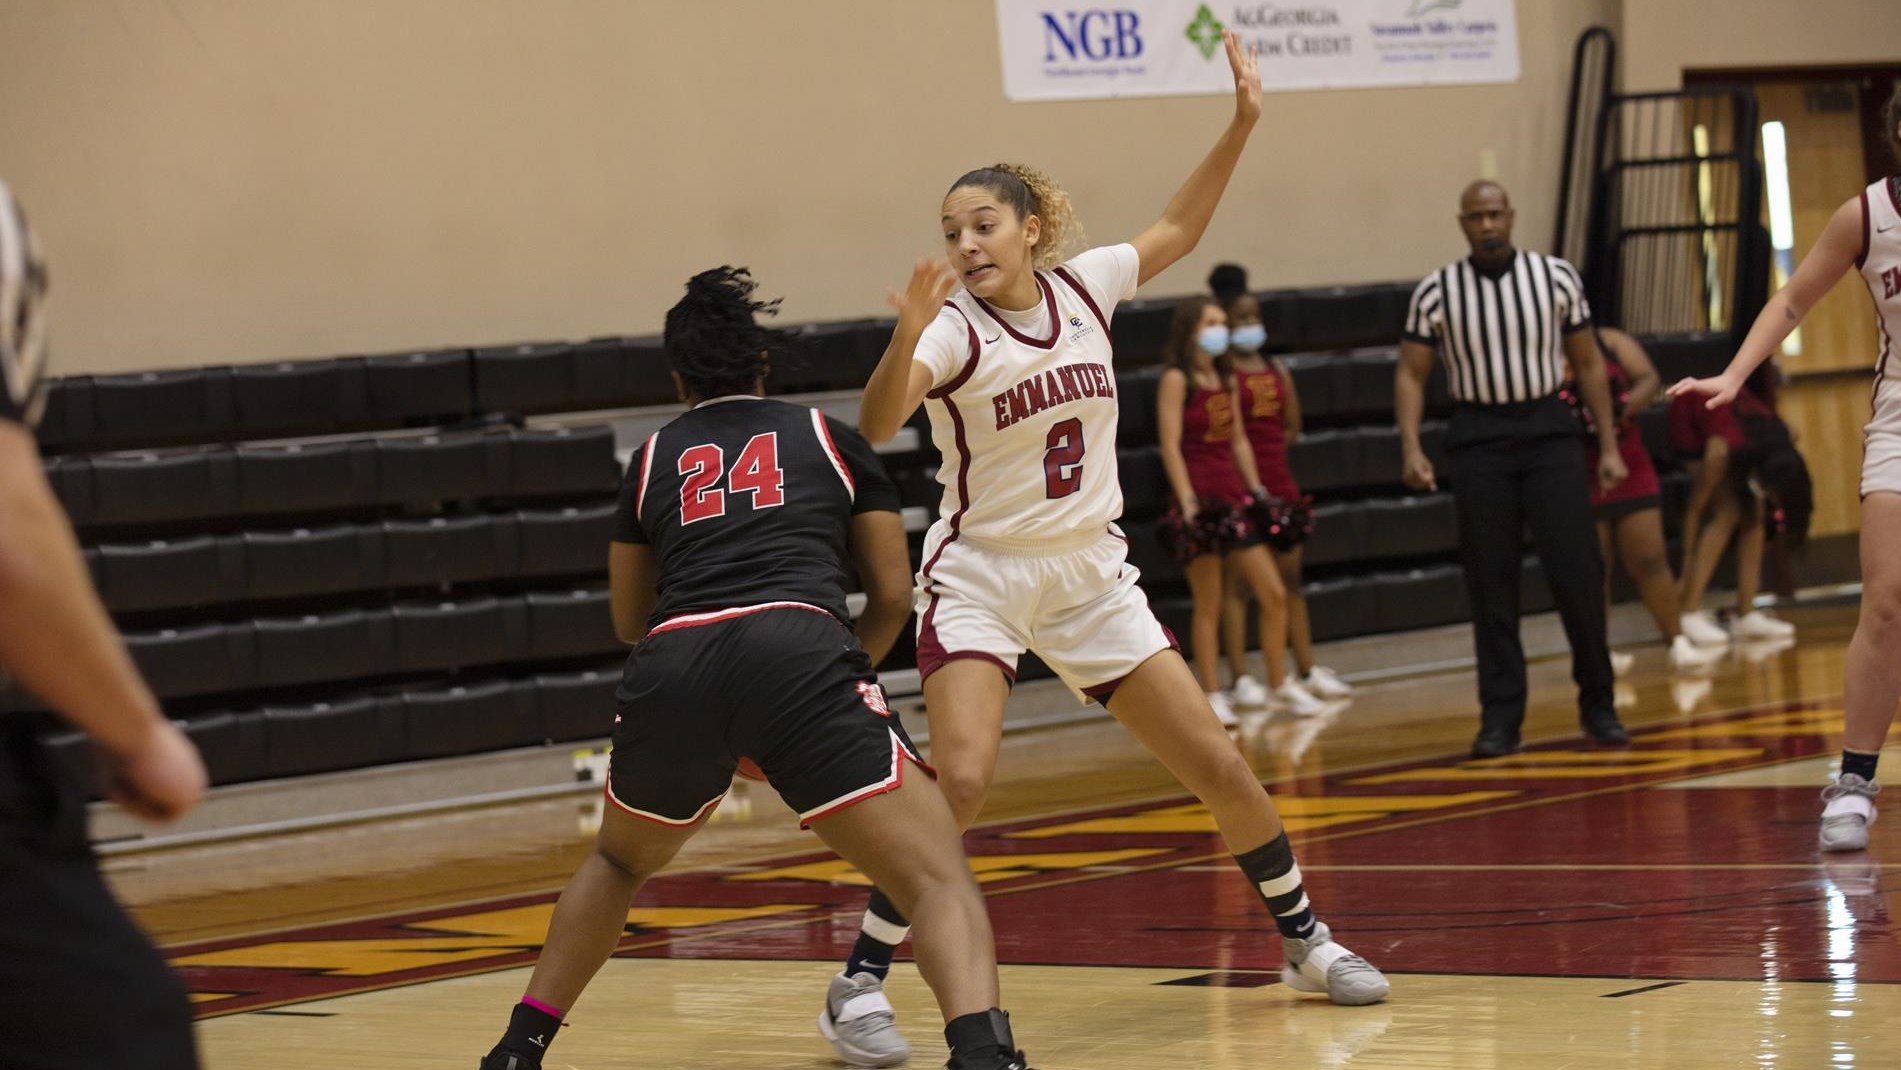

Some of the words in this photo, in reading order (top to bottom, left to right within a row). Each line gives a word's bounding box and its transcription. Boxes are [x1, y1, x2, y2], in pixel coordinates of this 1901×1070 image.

[1041, 10, 1143, 61] NGB
[992, 362, 1114, 431] EMMANUEL
[678, 431, 784, 526] 24
[1043, 416, 1085, 499] 2
